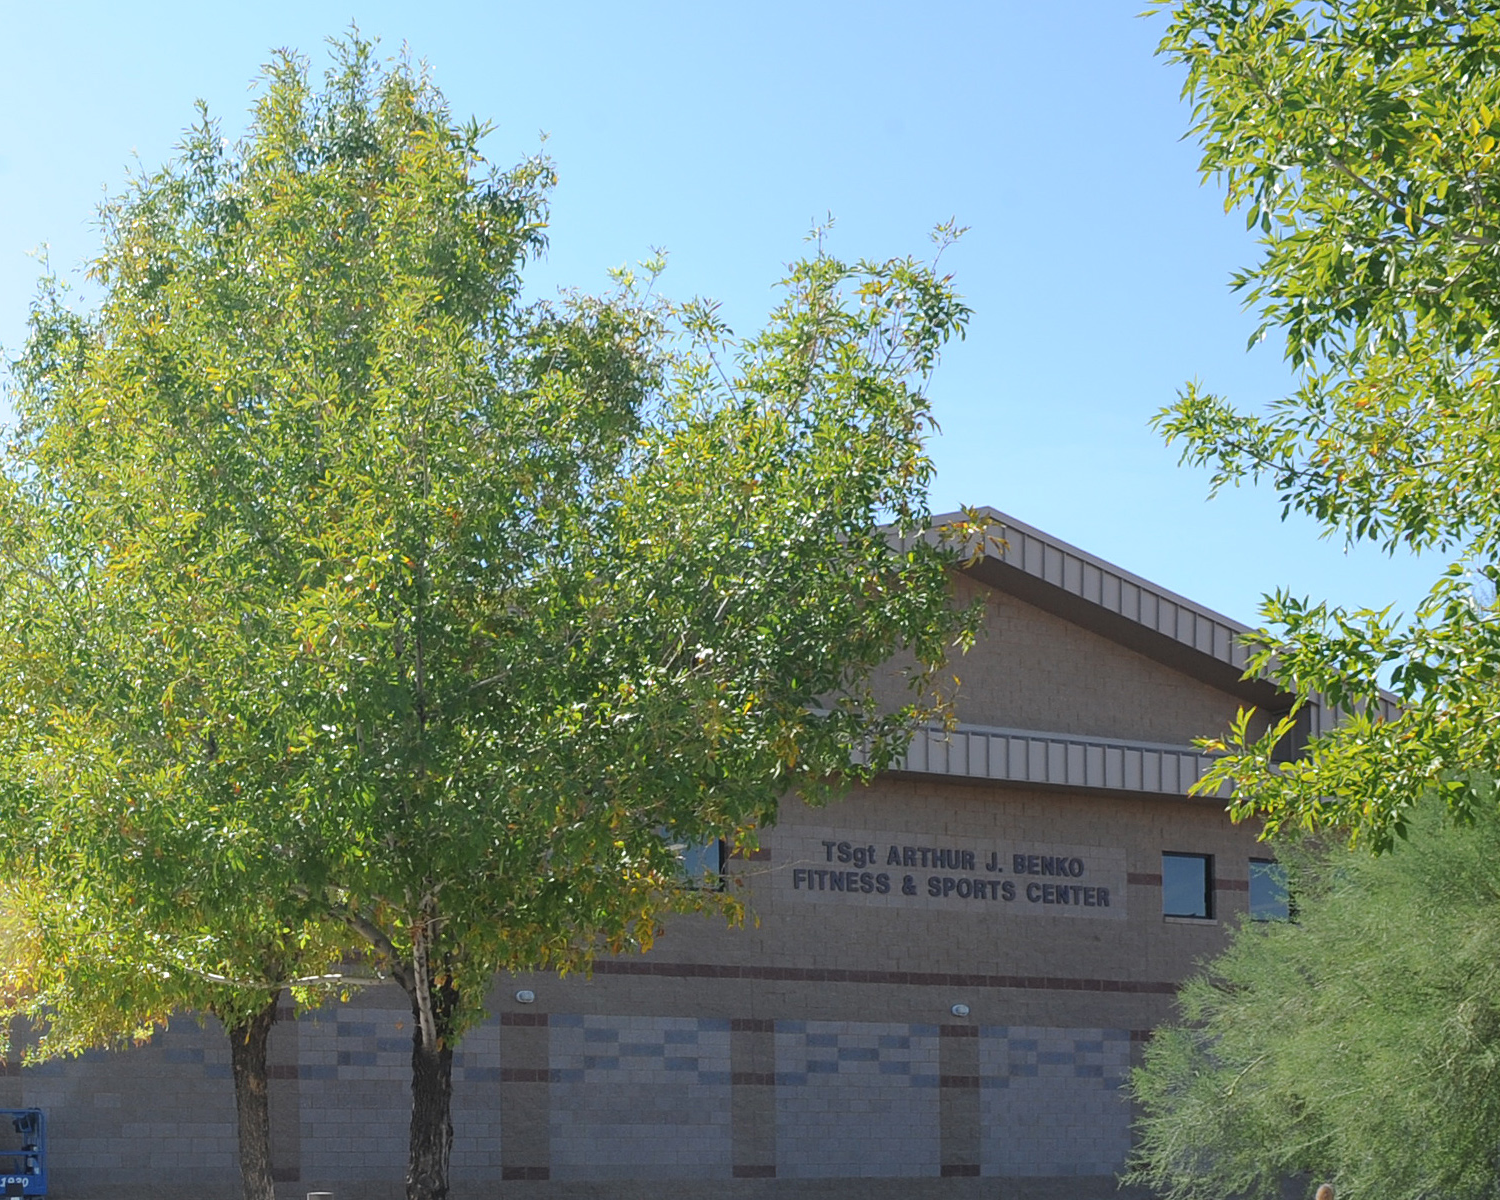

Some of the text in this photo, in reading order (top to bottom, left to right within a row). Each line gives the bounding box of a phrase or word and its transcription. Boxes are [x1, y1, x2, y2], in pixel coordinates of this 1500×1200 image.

[822, 841, 1084, 877] TSgt ARTHUR J. BENKO
[793, 869, 1110, 907] FITNESS & SPORTS CENTER
